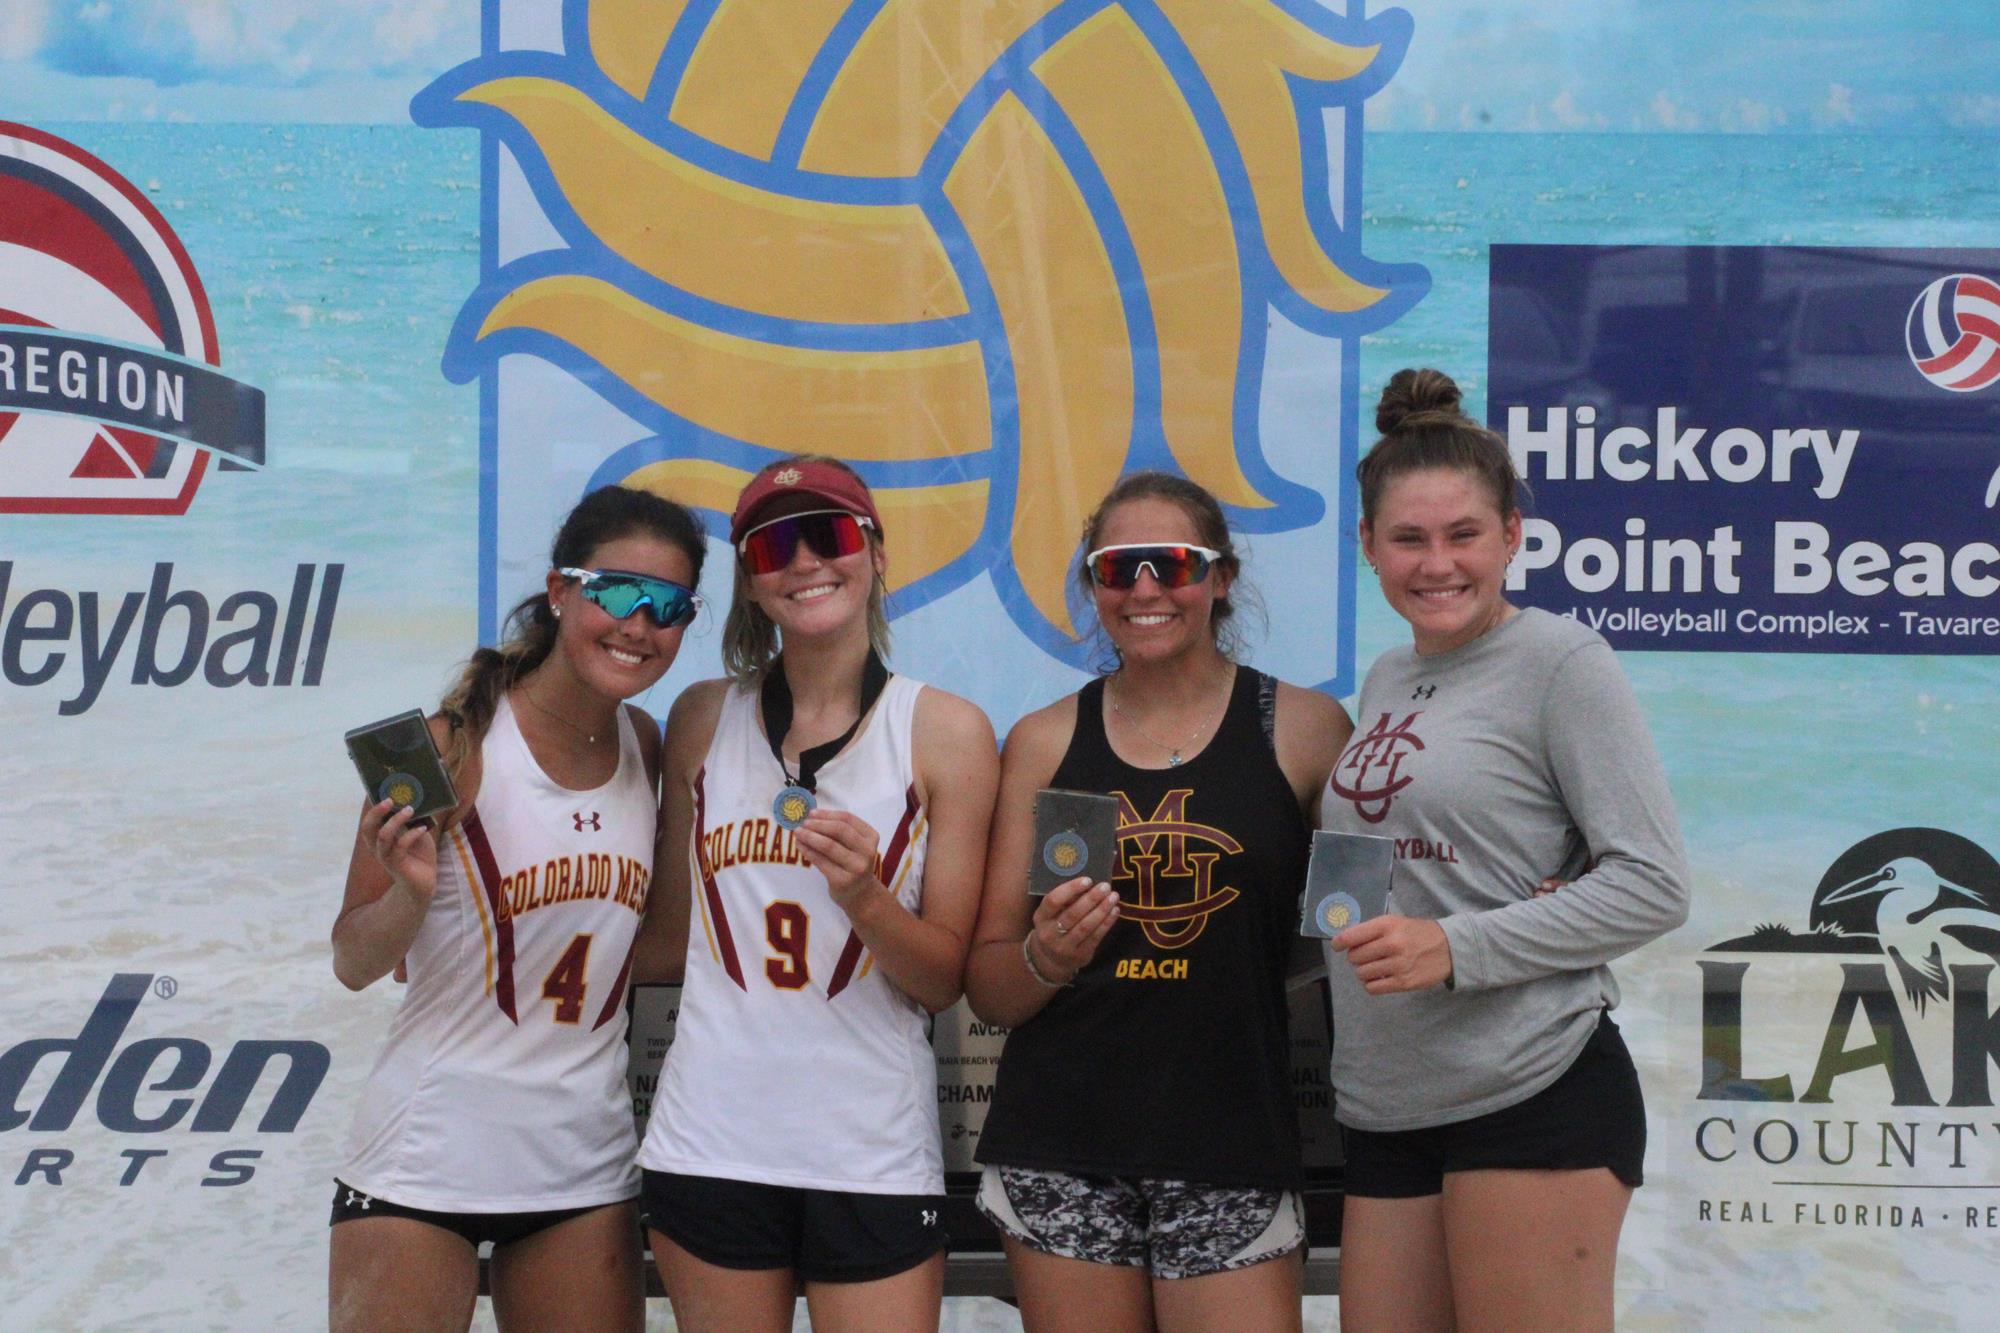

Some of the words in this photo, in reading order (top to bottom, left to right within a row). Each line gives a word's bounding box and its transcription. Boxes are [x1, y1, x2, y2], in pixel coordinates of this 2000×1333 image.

[0, 344, 184, 422] REGION
[1507, 405, 1860, 500] Hickory
[1505, 517, 1742, 595] Point
[1774, 520, 2000, 598] Beac
[1586, 607, 1727, 637] Volleyball
[1736, 609, 1870, 639] Complex
[1899, 611, 2000, 636] Tavare
[498, 853, 612, 923] COLORADO
[541, 932, 594, 1026] 4
[764, 899, 812, 991] 9
[1115, 958, 1190, 980] BEACH
[1695, 1116, 2000, 1169] COUNT
[1700, 1200, 1774, 1224] REAL
[1795, 1203, 1925, 1228] FLORIDA
